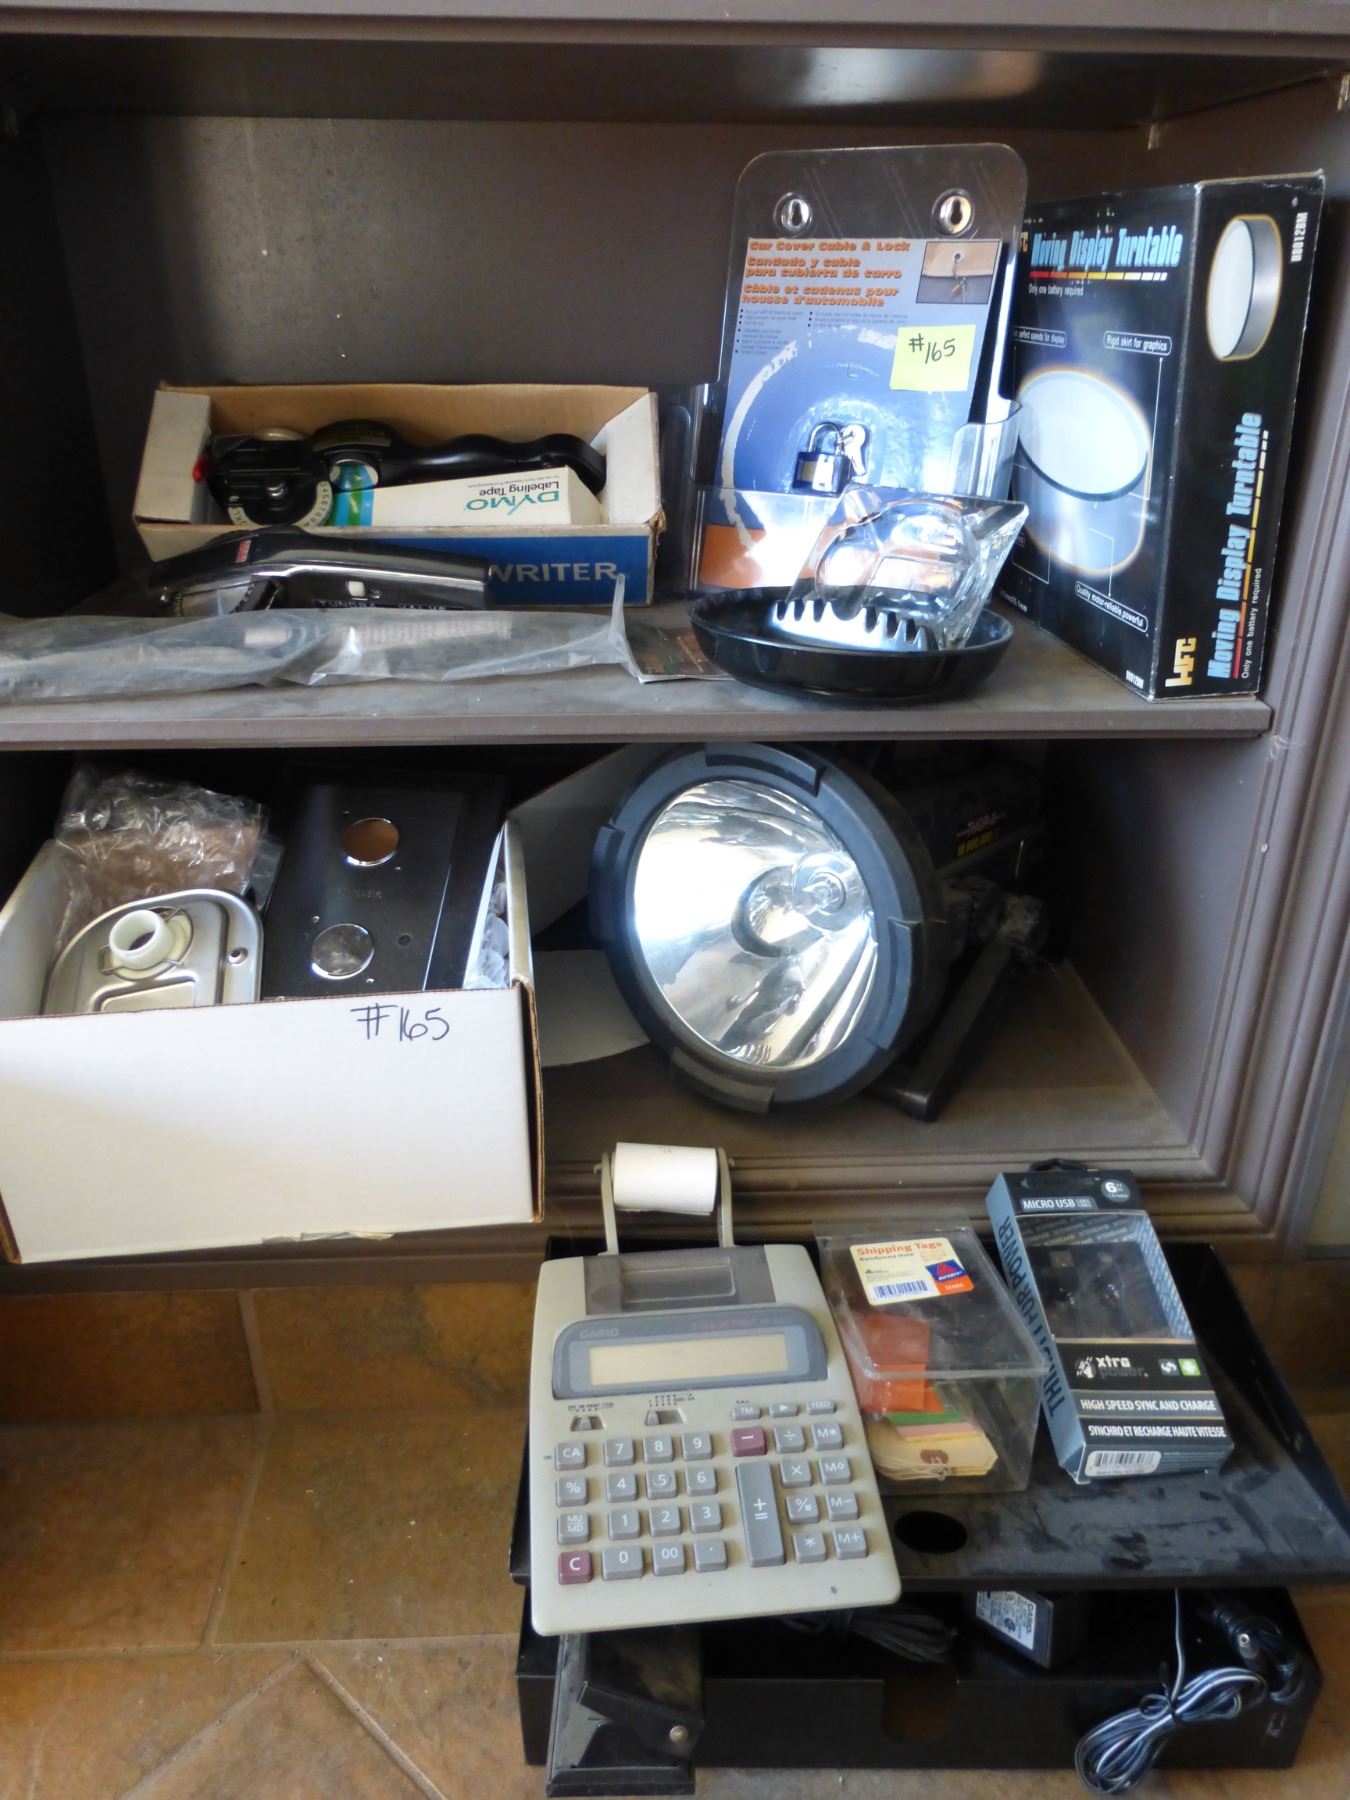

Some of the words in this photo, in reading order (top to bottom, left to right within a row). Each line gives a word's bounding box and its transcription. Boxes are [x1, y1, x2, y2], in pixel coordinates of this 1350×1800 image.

[776, 241, 815, 250] Cover
[818, 241, 856, 251] Cable
[1031, 232, 1067, 272] Moving
[1069, 229, 1113, 272] Display
[1115, 225, 1183, 267] Turntable
[823, 257, 860, 267] cable
[843, 268, 860, 278] de
[908, 333, 955, 364] #165
[1134, 337, 1142, 348] for
[1143, 339, 1168, 353] graphics
[1226, 412, 1262, 515] Turntable
[479, 486, 505, 496] Tape
[508, 481, 559, 493] Labeling
[465, 490, 560, 516] DYMO
[1216, 523, 1251, 601] Display
[1251, 567, 1262, 604] required
[1246, 606, 1259, 638] battery
[1207, 608, 1241, 679] Moving
[1245, 640, 1254, 656] one
[1241, 659, 1252, 679] Only
[351, 1002, 450, 1042] #165
[1105, 1181, 1117, 1194] 6
[1022, 1199, 1055, 1209] MICRO
[1055, 1198, 1076, 1208] USB
[857, 1243, 912, 1256] Shipping
[915, 1241, 943, 1251] Tags
[999, 1216, 1028, 1289] POWER
[1096, 1354, 1131, 1368] xtra
[1080, 1398, 1105, 1411] HIGH
[1105, 1399, 1134, 1411] SPEED
[1135, 1399, 1160, 1411] SYNC
[1160, 1400, 1179, 1411] AND
[1180, 1400, 1217, 1411] CHARGE
[1088, 1424, 1124, 1437] SYNCHRO
[1124, 1425, 1133, 1437] ET
[1134, 1425, 1172, 1437] RECHARGE
[1172, 1426, 1197, 1438] HAUTE
[1196, 1426, 1227, 1438] VITESSE
[615, 1443, 624, 1455] 7
[654, 1440, 663, 1452] 8
[693, 1437, 702, 1449] 9
[563, 1447, 581, 1458] CA
[657, 1474, 666, 1486] 5
[697, 1471, 706, 1483] 6
[566, 1482, 581, 1494] %
[617, 1478, 626, 1490] 4
[661, 1511, 670, 1523] 2
[702, 1507, 711, 1519] 3
[621, 1515, 628, 1527] 1
[618, 1551, 629, 1564] 0
[661, 1547, 678, 1560] 00
[569, 1557, 581, 1571] C
